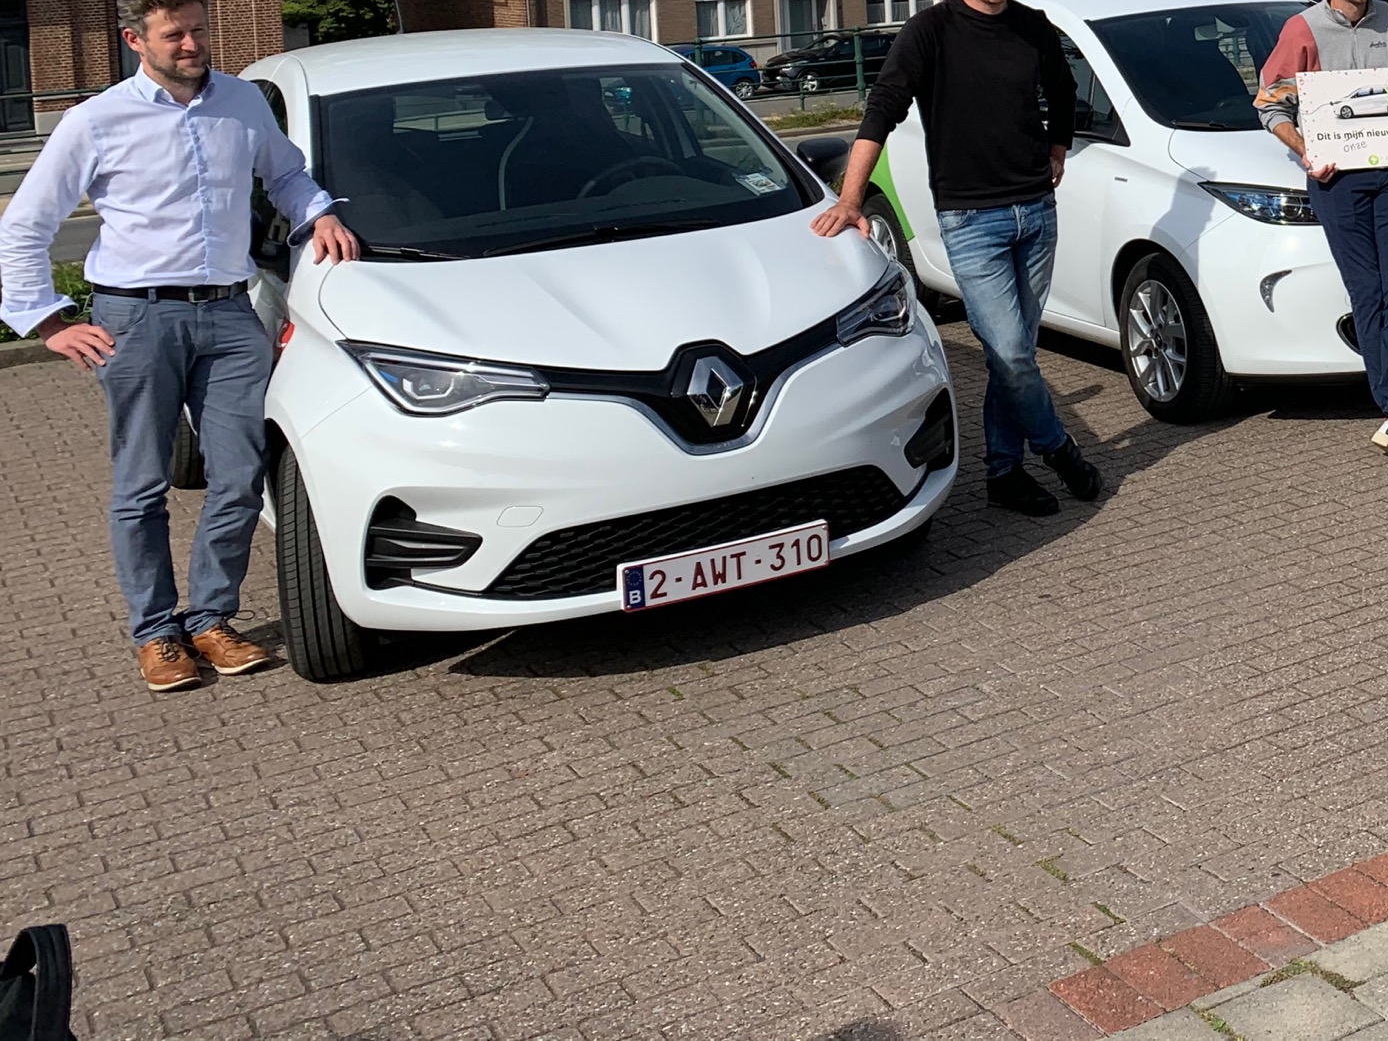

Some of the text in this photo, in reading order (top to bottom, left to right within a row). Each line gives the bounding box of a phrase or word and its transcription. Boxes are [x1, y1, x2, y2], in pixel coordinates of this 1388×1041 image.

[1316, 130, 1332, 141] Dit
[1333, 130, 1342, 140] is
[1343, 141, 1367, 153] onze
[628, 533, 823, 605] B 2-AWT-310
